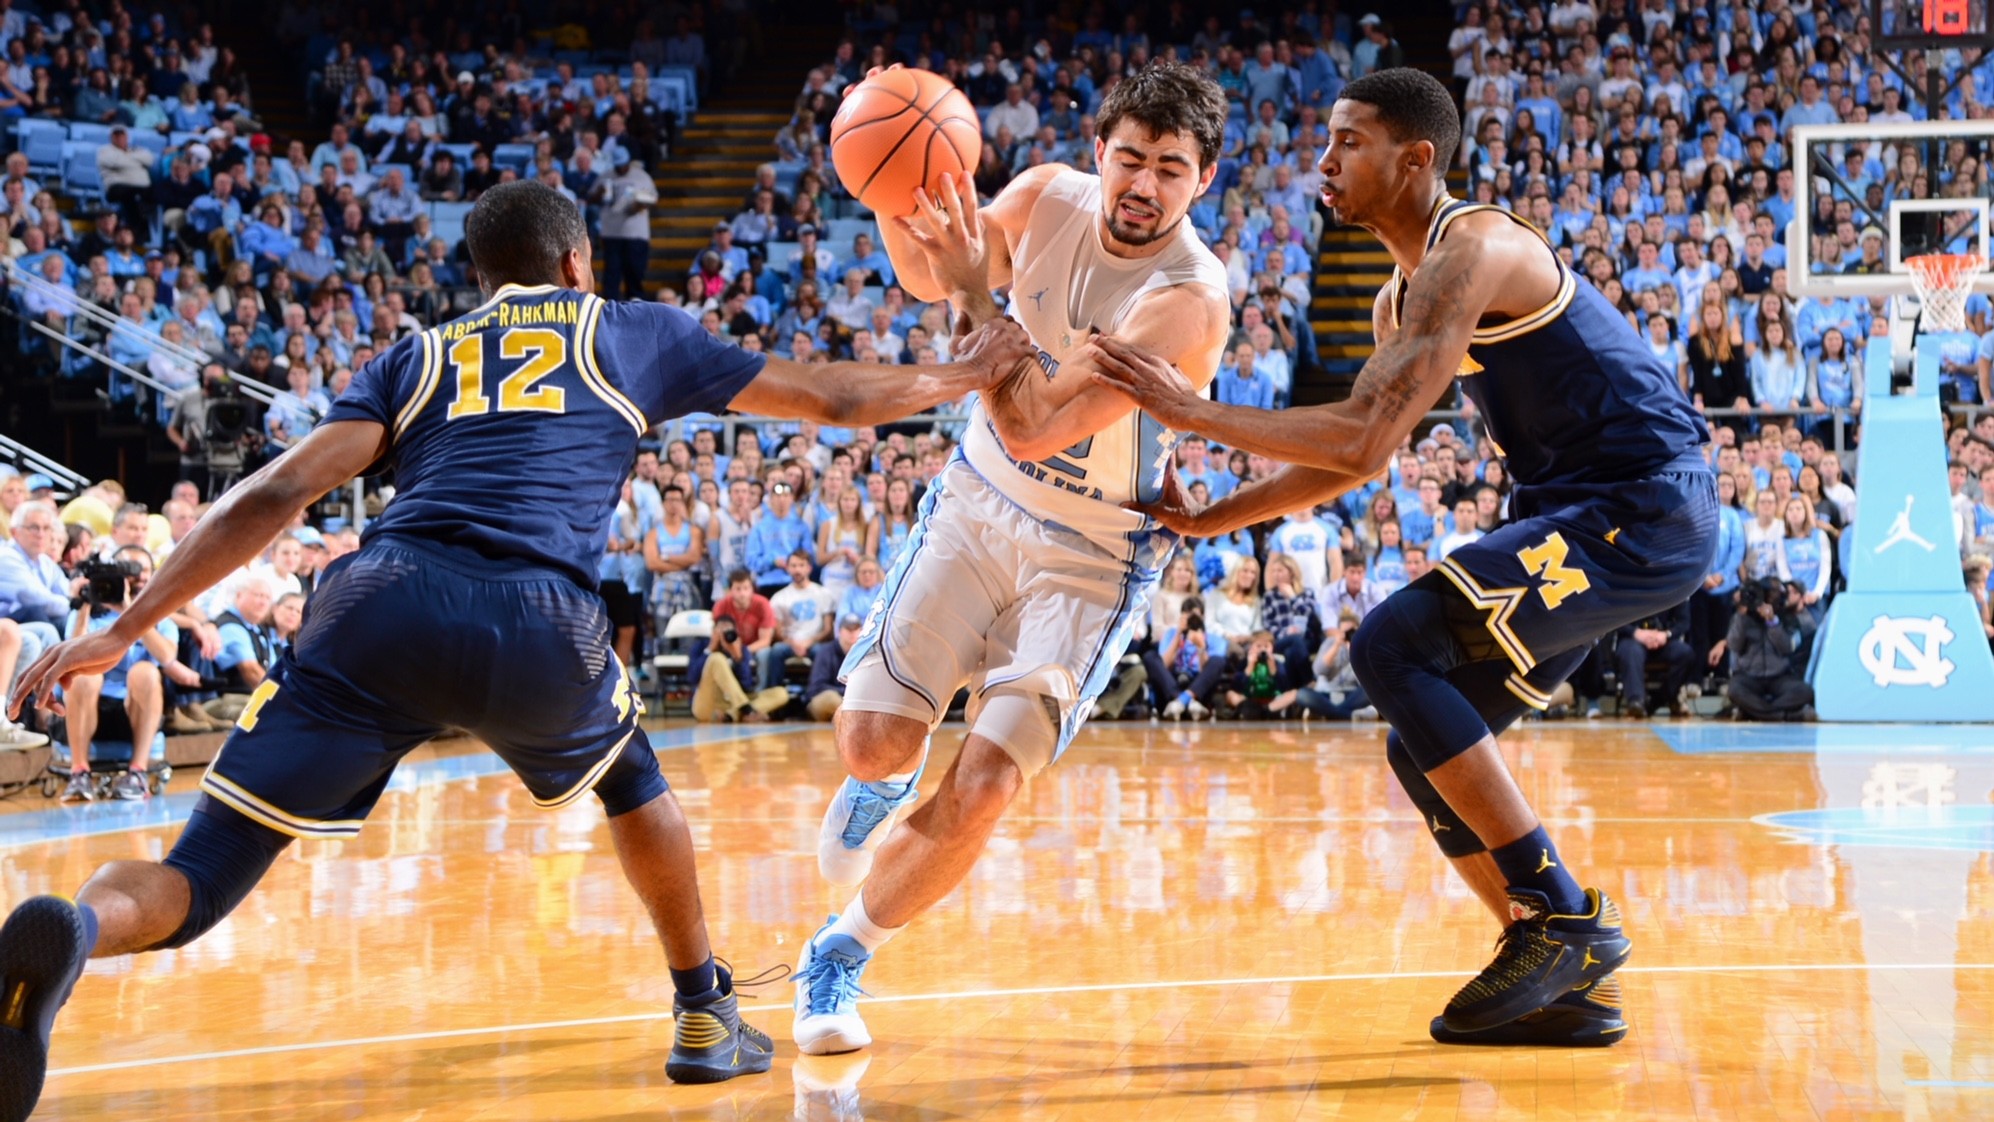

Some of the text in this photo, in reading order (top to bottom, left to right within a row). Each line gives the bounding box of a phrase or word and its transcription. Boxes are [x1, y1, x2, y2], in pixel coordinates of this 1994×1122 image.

[442, 301, 578, 340] ABD-RAHKMAN
[447, 327, 567, 421] 12
[1517, 531, 1591, 610] M
